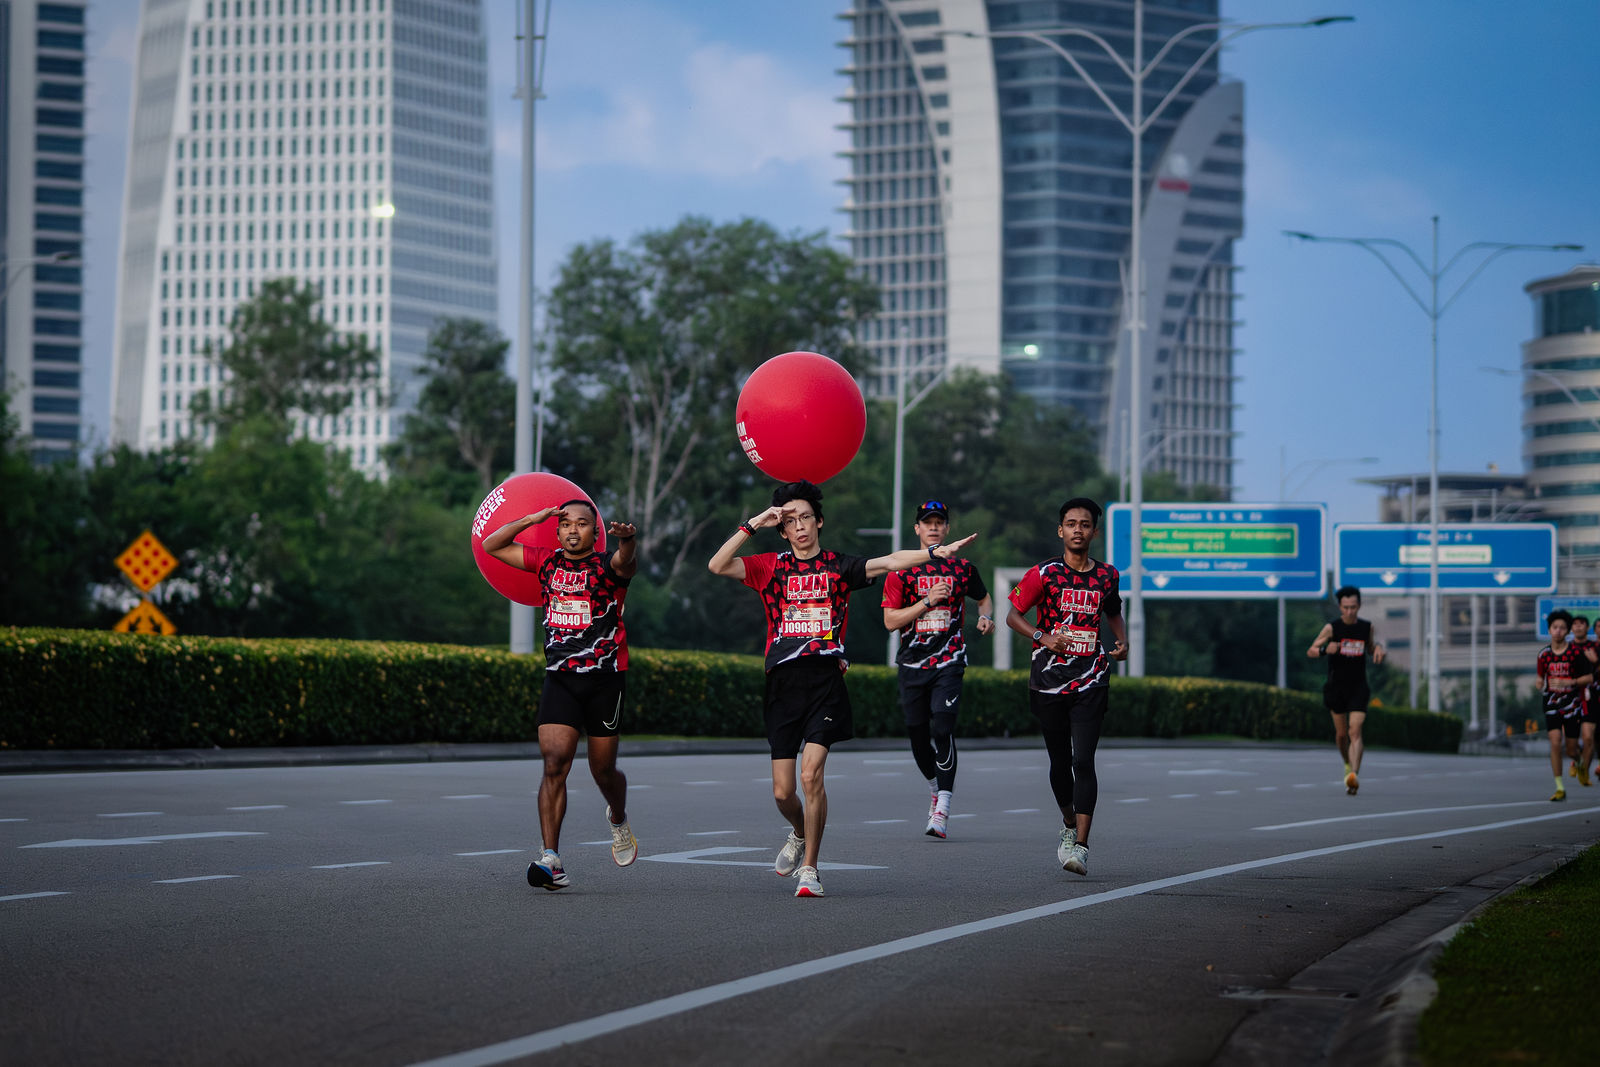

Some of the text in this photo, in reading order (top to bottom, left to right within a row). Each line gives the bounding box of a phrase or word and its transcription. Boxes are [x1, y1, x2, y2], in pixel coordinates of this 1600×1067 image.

[475, 495, 506, 538] PACER
[553, 568, 587, 585] RUN
[787, 572, 829, 592] RUN
[1061, 588, 1100, 608] RUN
[551, 612, 580, 626] J09040
[784, 621, 821, 633] J09036
